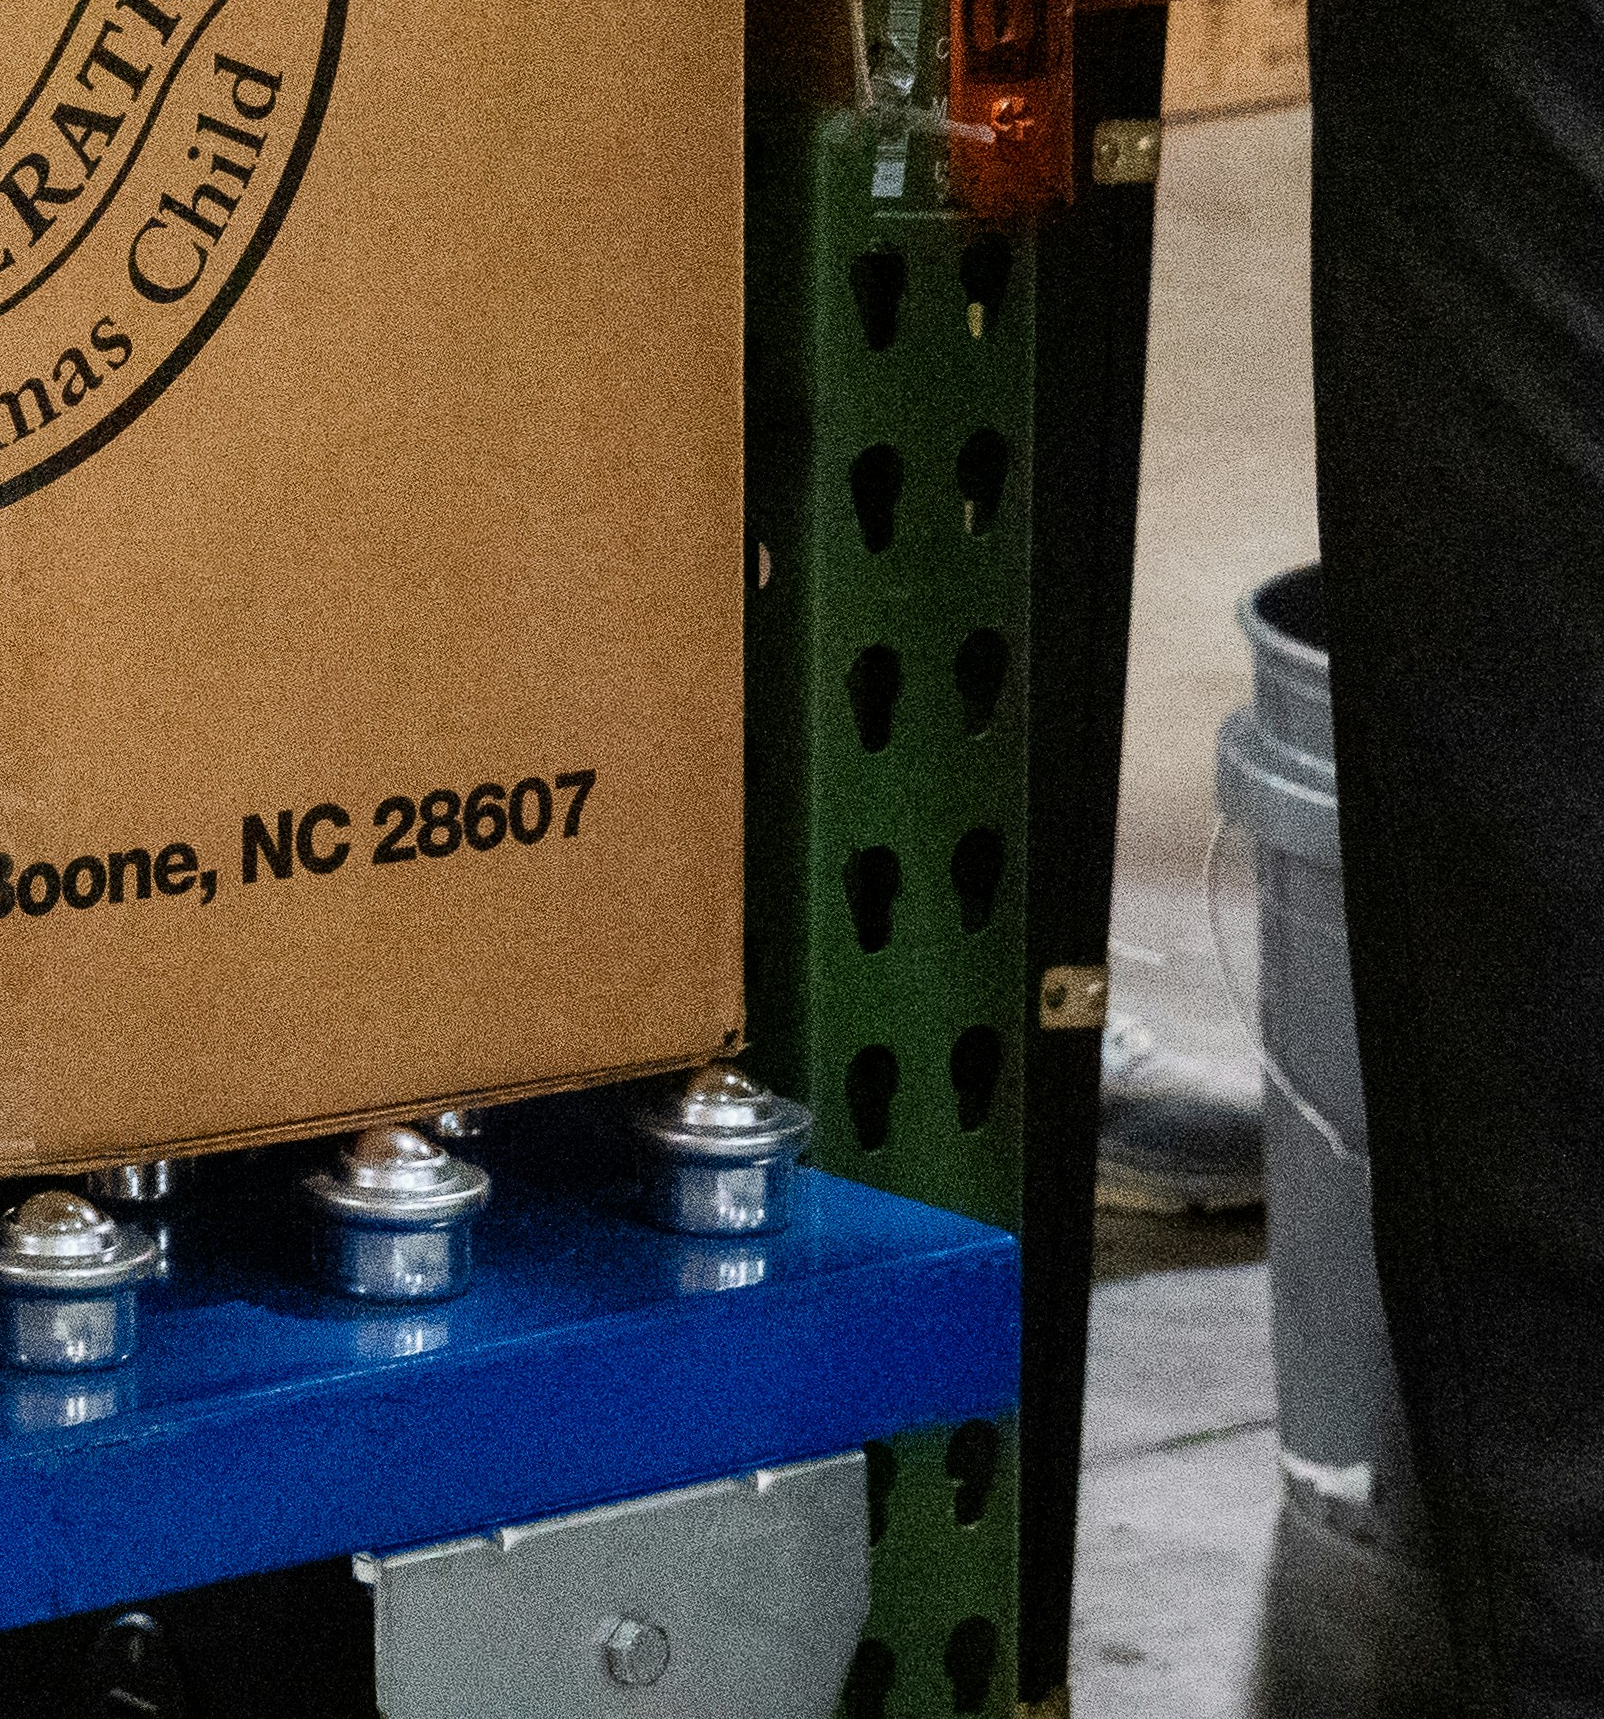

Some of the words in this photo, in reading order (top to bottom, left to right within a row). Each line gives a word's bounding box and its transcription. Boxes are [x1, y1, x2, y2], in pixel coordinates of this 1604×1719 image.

[128, 54, 284, 306] Child
[240, 799, 352, 886] NC
[371, 767, 598, 868] 28607
